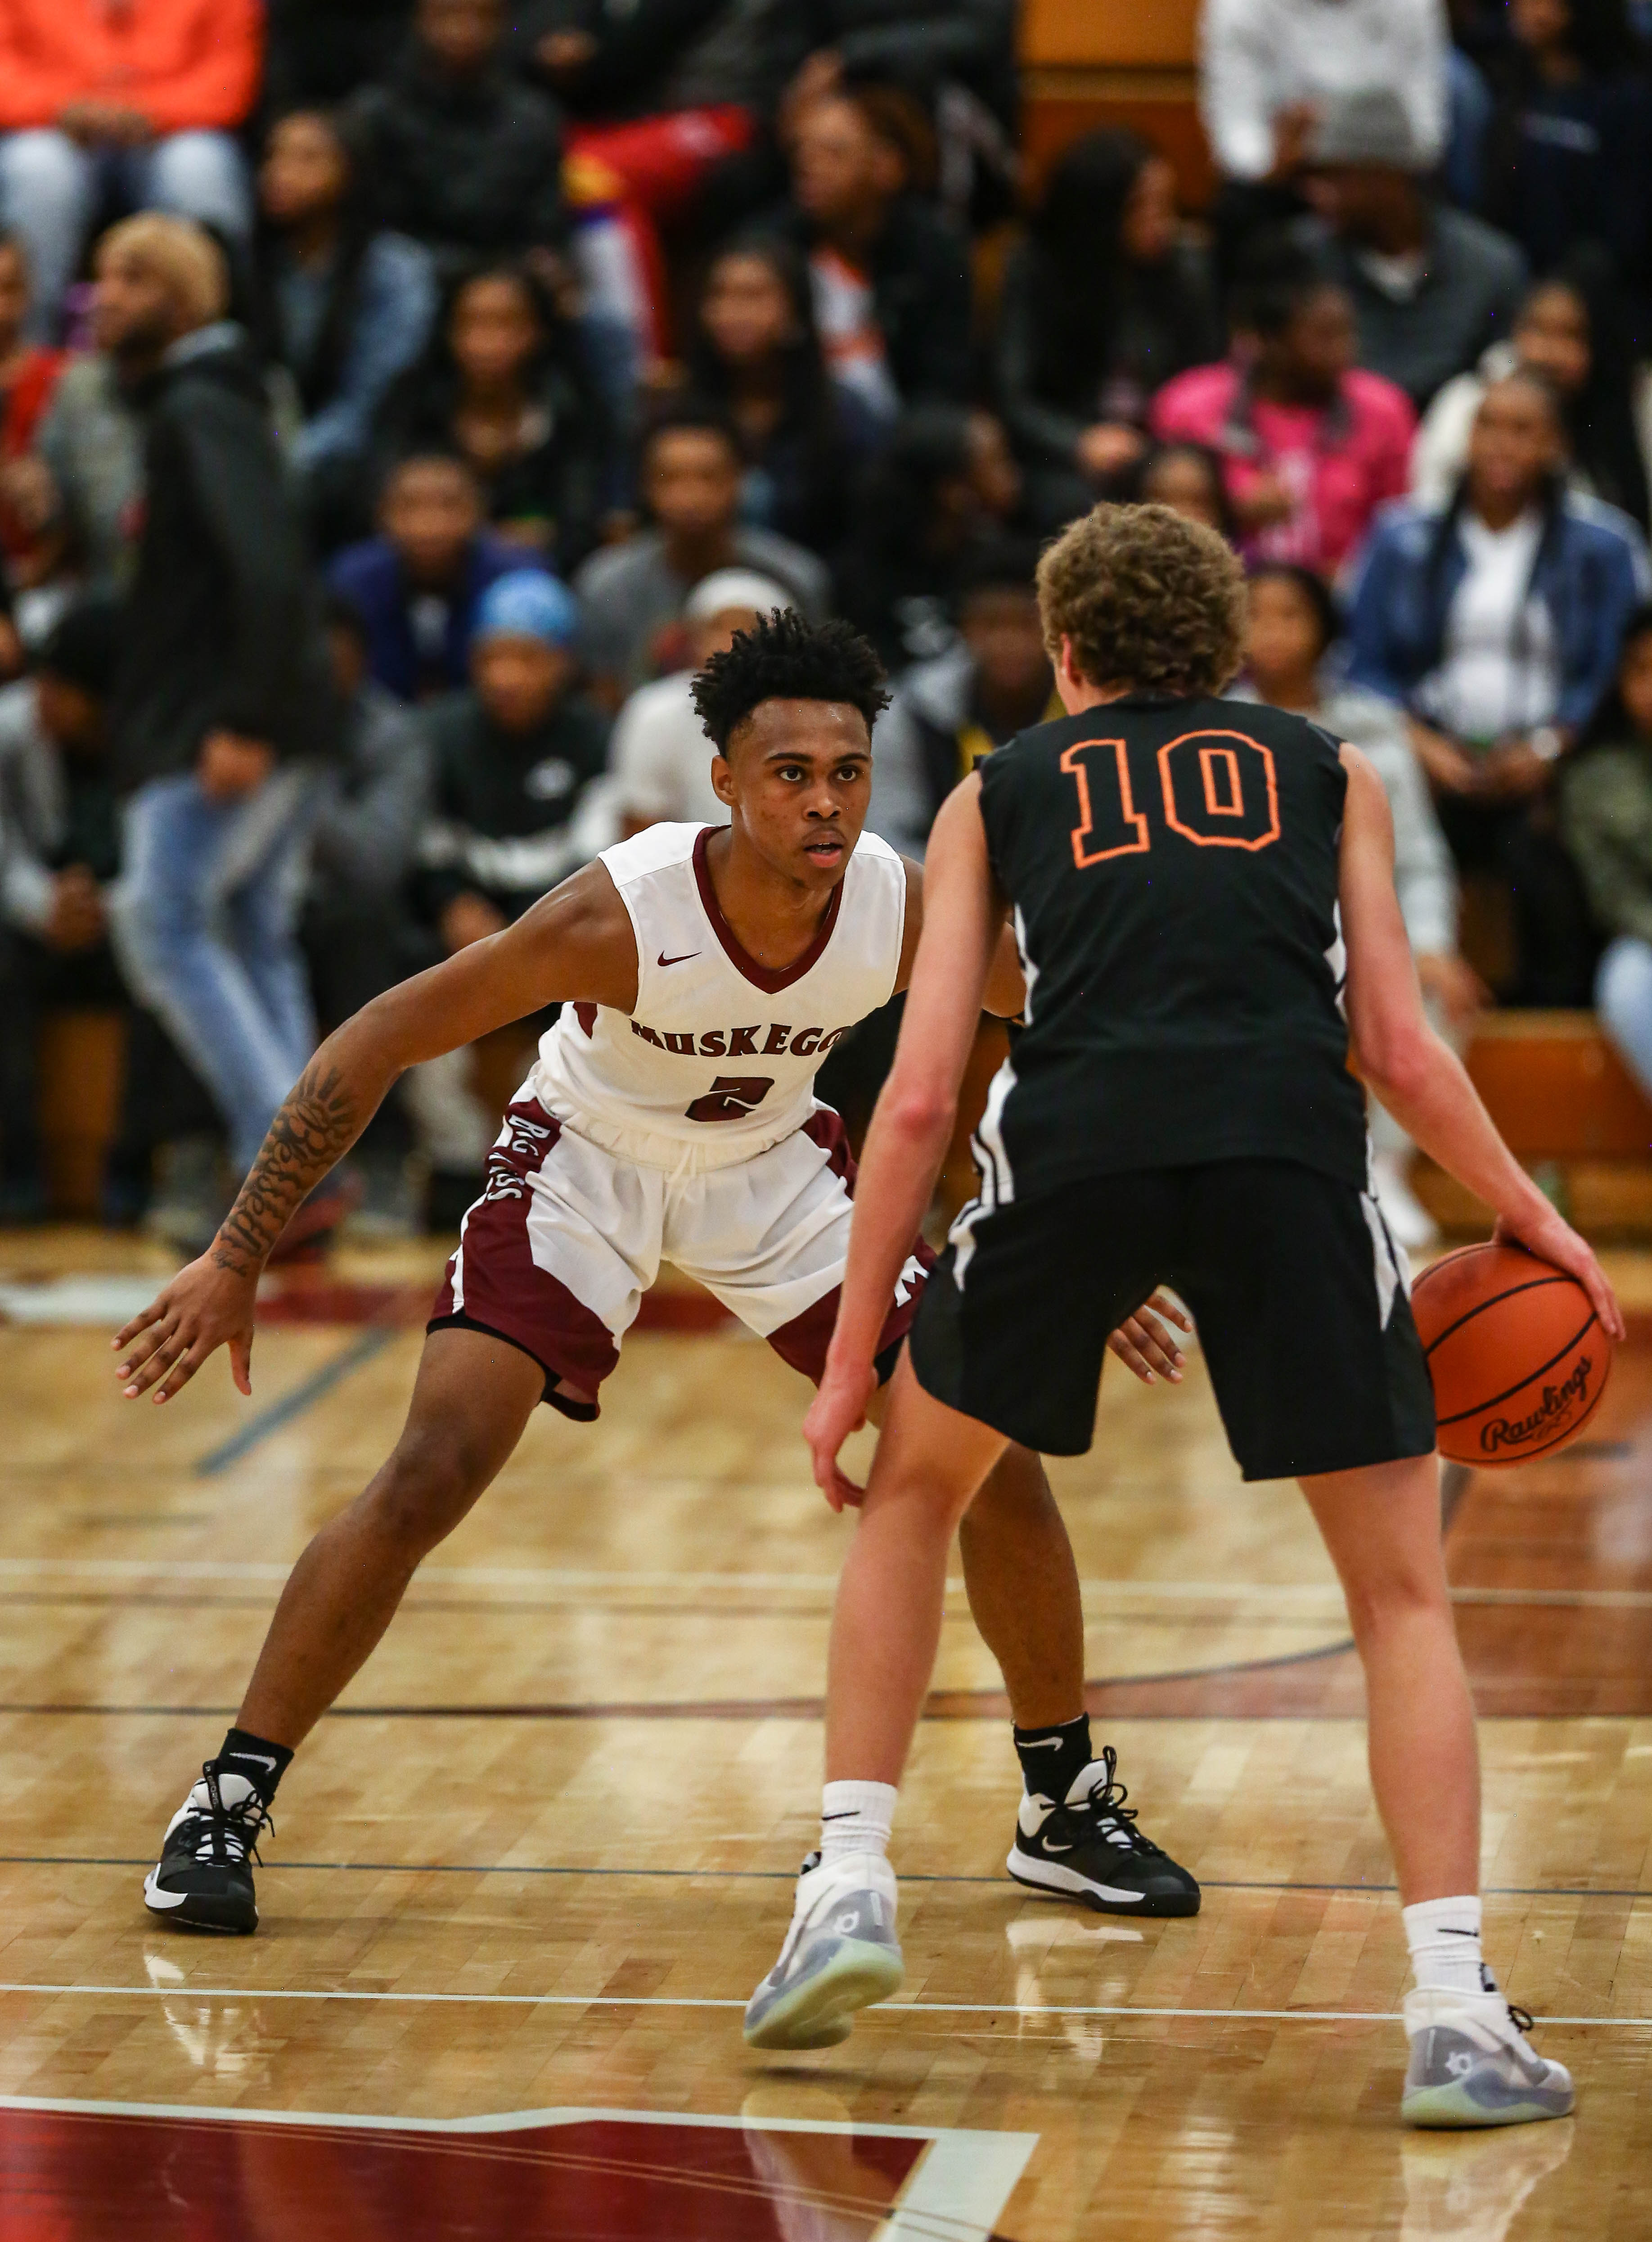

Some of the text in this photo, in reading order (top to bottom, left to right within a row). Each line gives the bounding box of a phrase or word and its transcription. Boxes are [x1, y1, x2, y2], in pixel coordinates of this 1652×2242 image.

[1060, 729, 1281, 870] 10
[684, 1076, 775, 1122] 2
[1481, 1355, 1592, 1452] Rawlings
